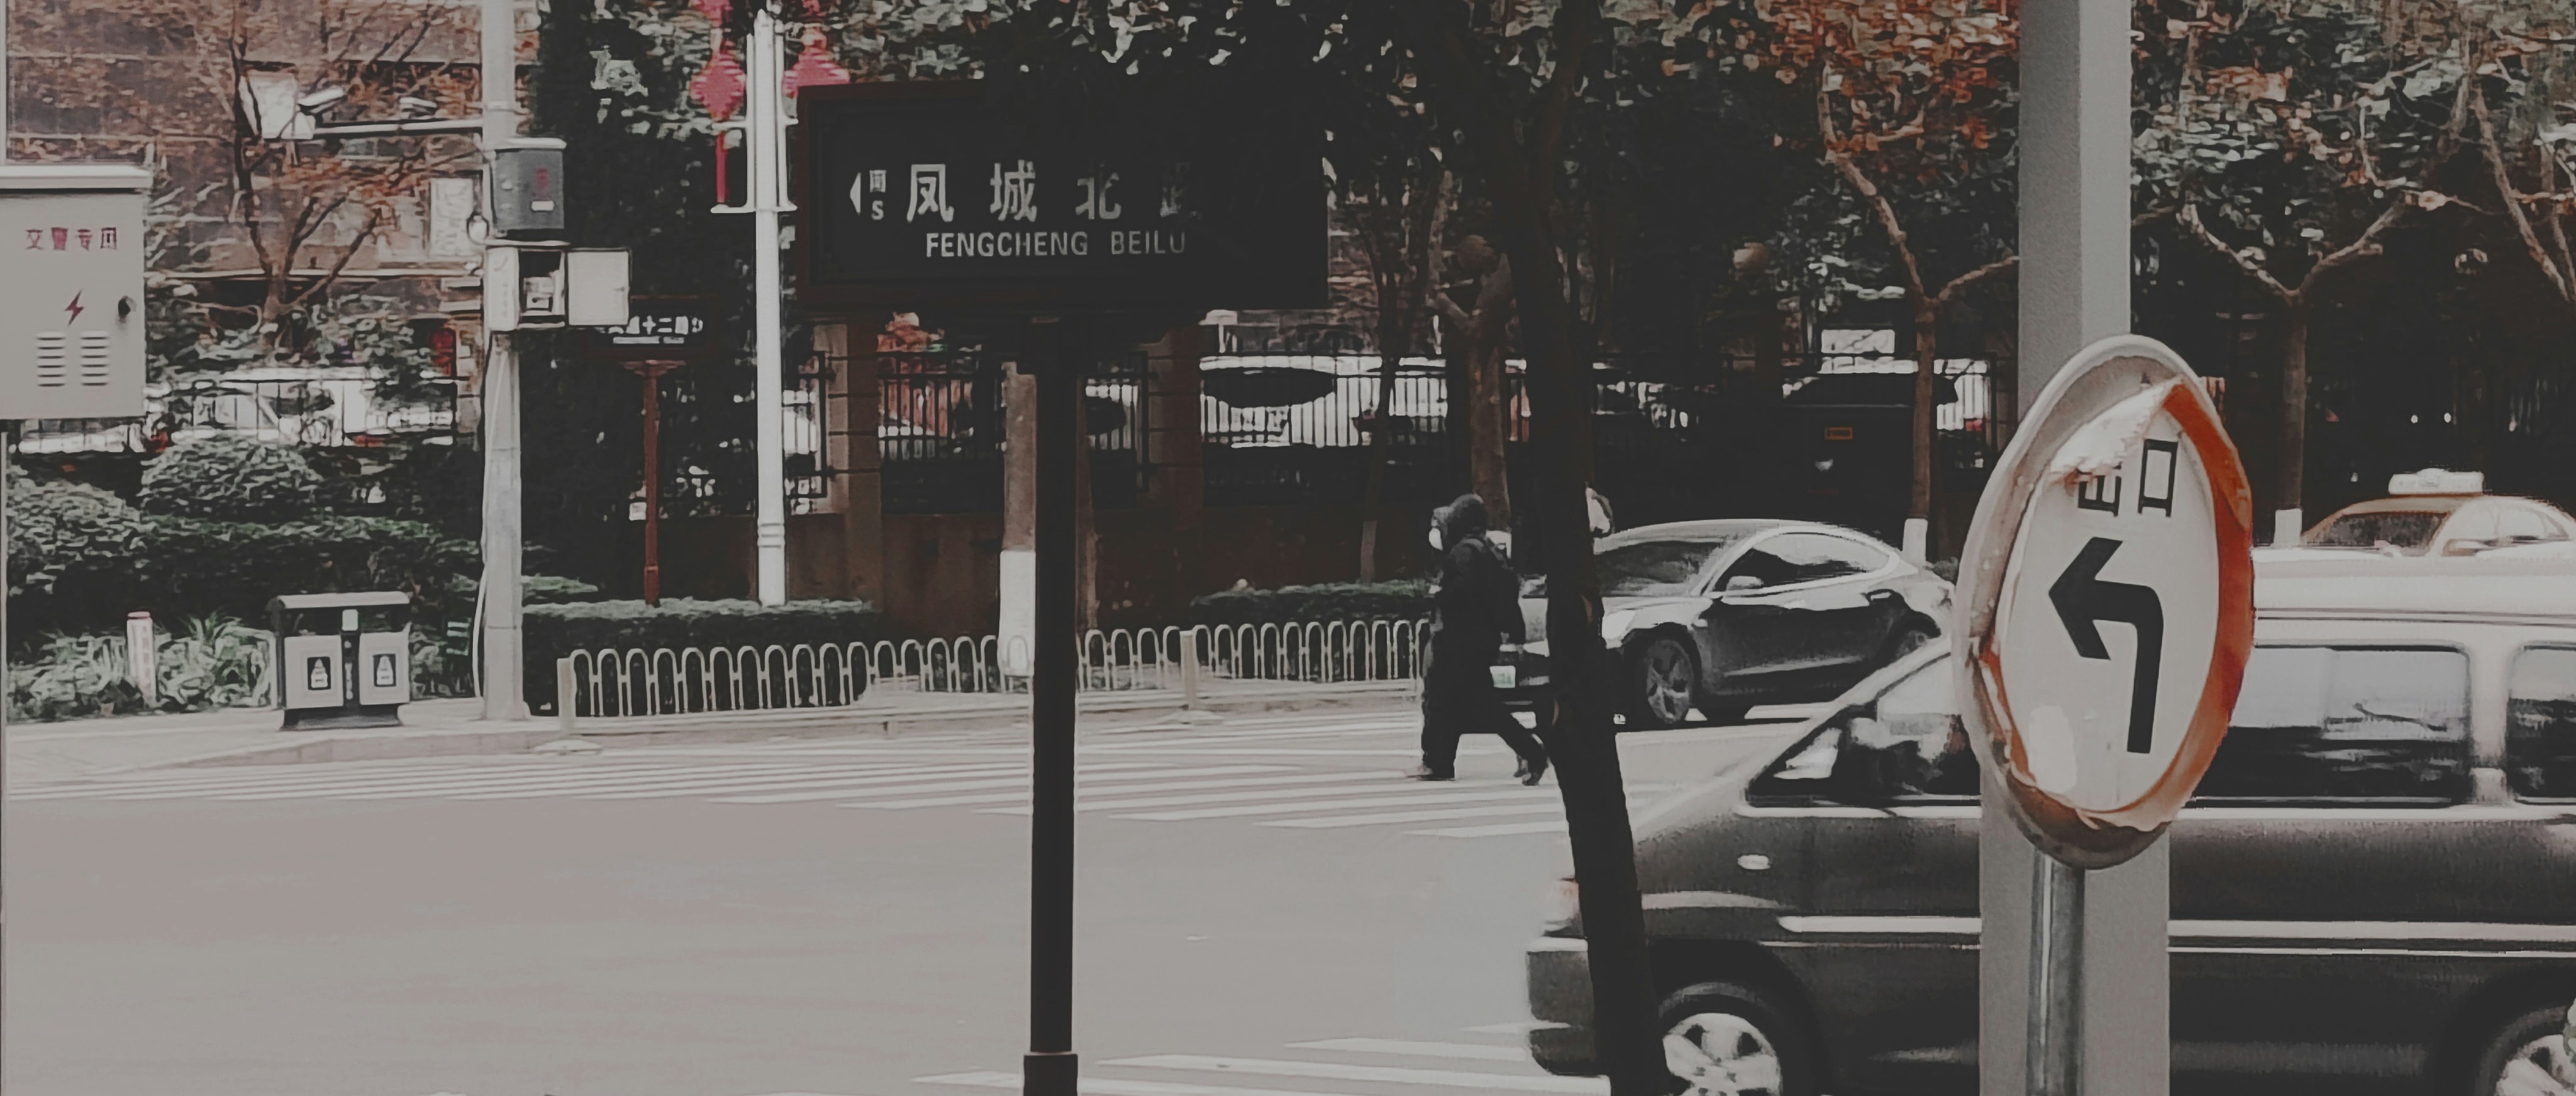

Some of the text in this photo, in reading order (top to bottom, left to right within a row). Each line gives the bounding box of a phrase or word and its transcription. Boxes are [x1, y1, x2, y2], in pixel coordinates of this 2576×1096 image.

[871, 200, 884, 221] S
[926, 230, 1186, 258] FENGCHENG BEILU
